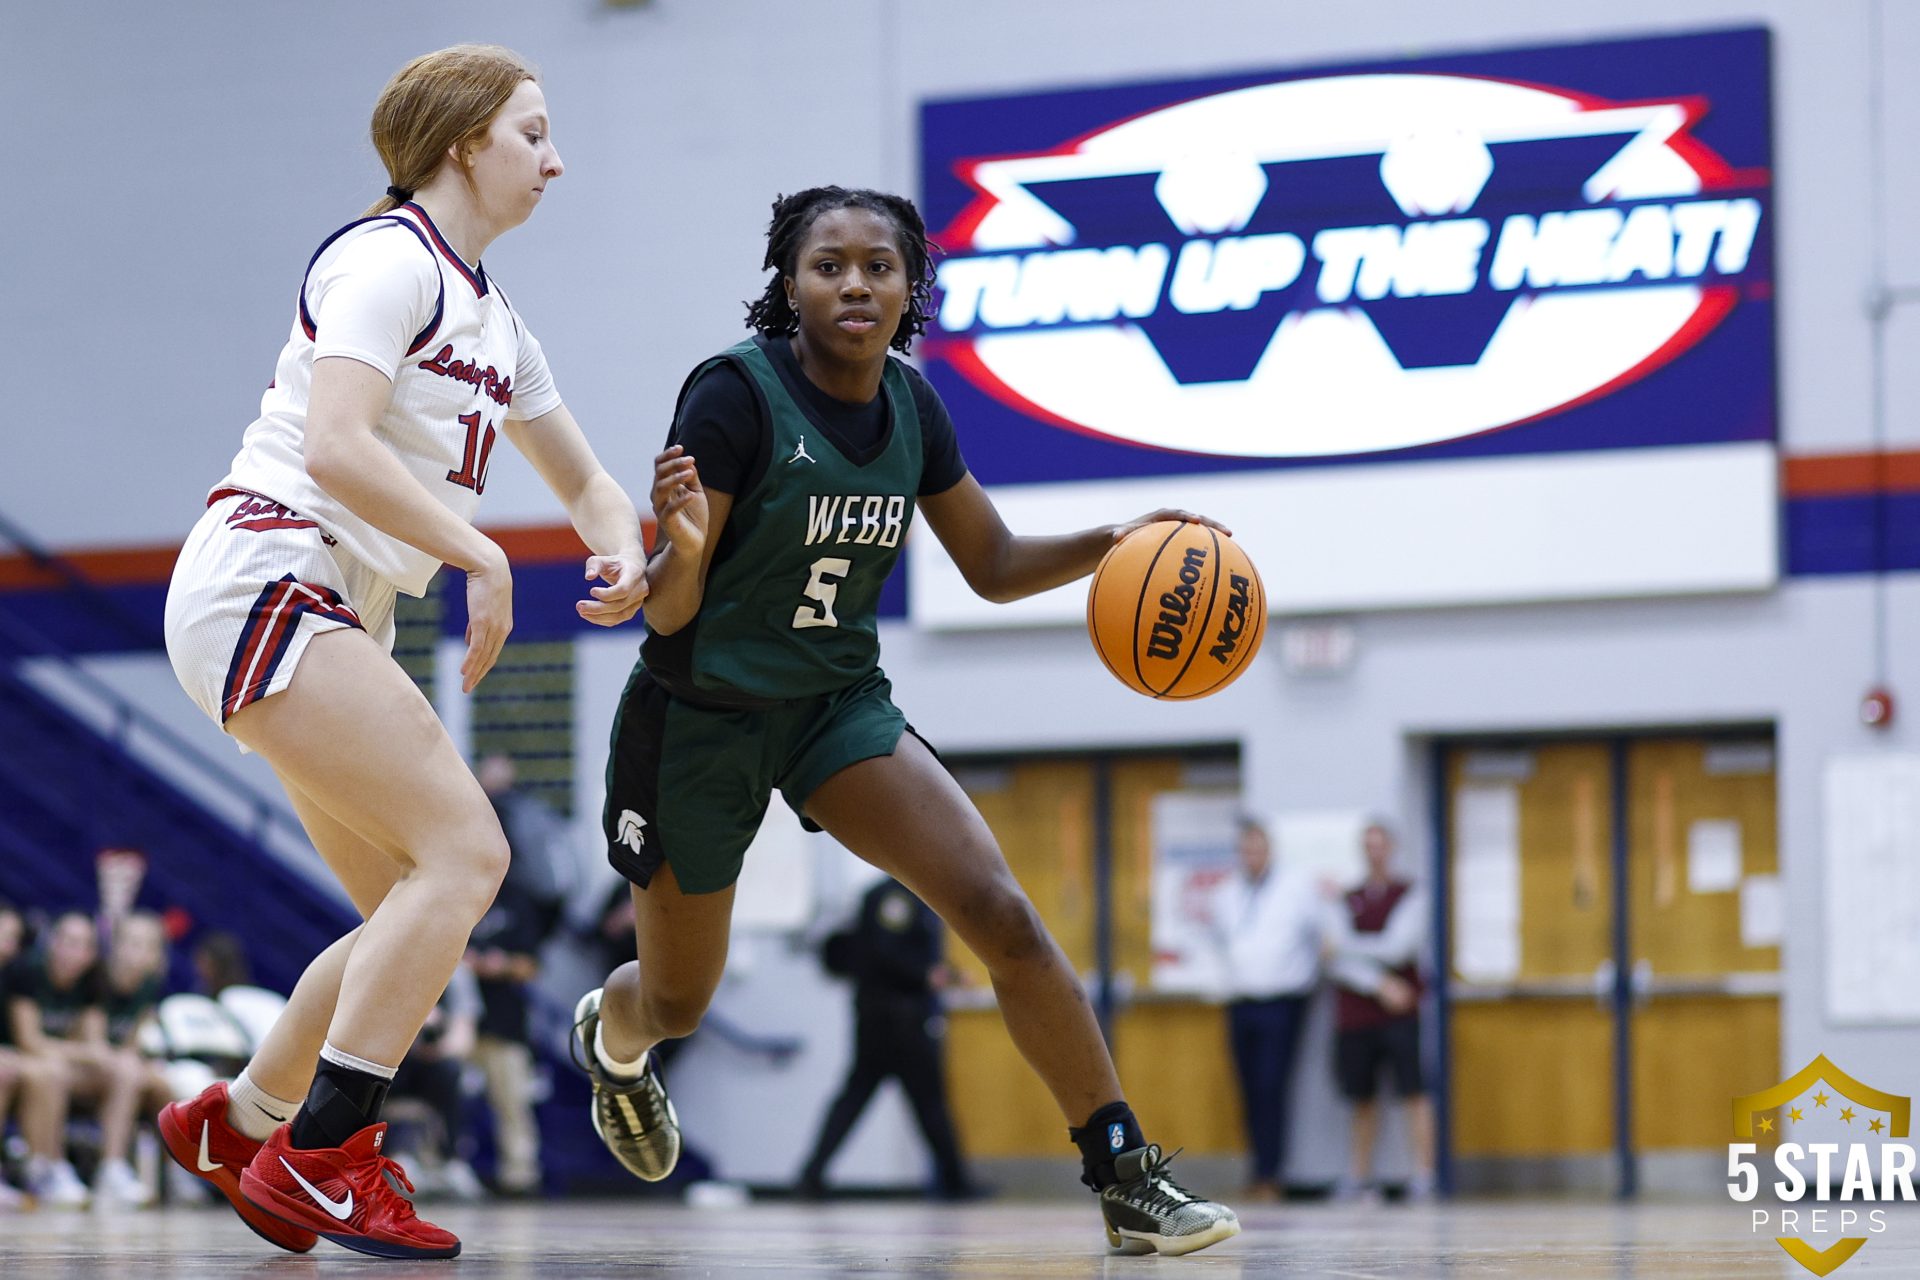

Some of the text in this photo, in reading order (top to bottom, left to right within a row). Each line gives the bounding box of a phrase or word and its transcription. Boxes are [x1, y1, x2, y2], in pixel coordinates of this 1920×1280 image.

[937, 198, 1761, 331] TURN UP THE HEAT!
[418, 344, 484, 395] Lady
[804, 496, 906, 548] WEBB
[792, 557, 851, 629] 5
[1147, 547, 1207, 660] Wilson
[1209, 573, 1249, 665] NCAA
